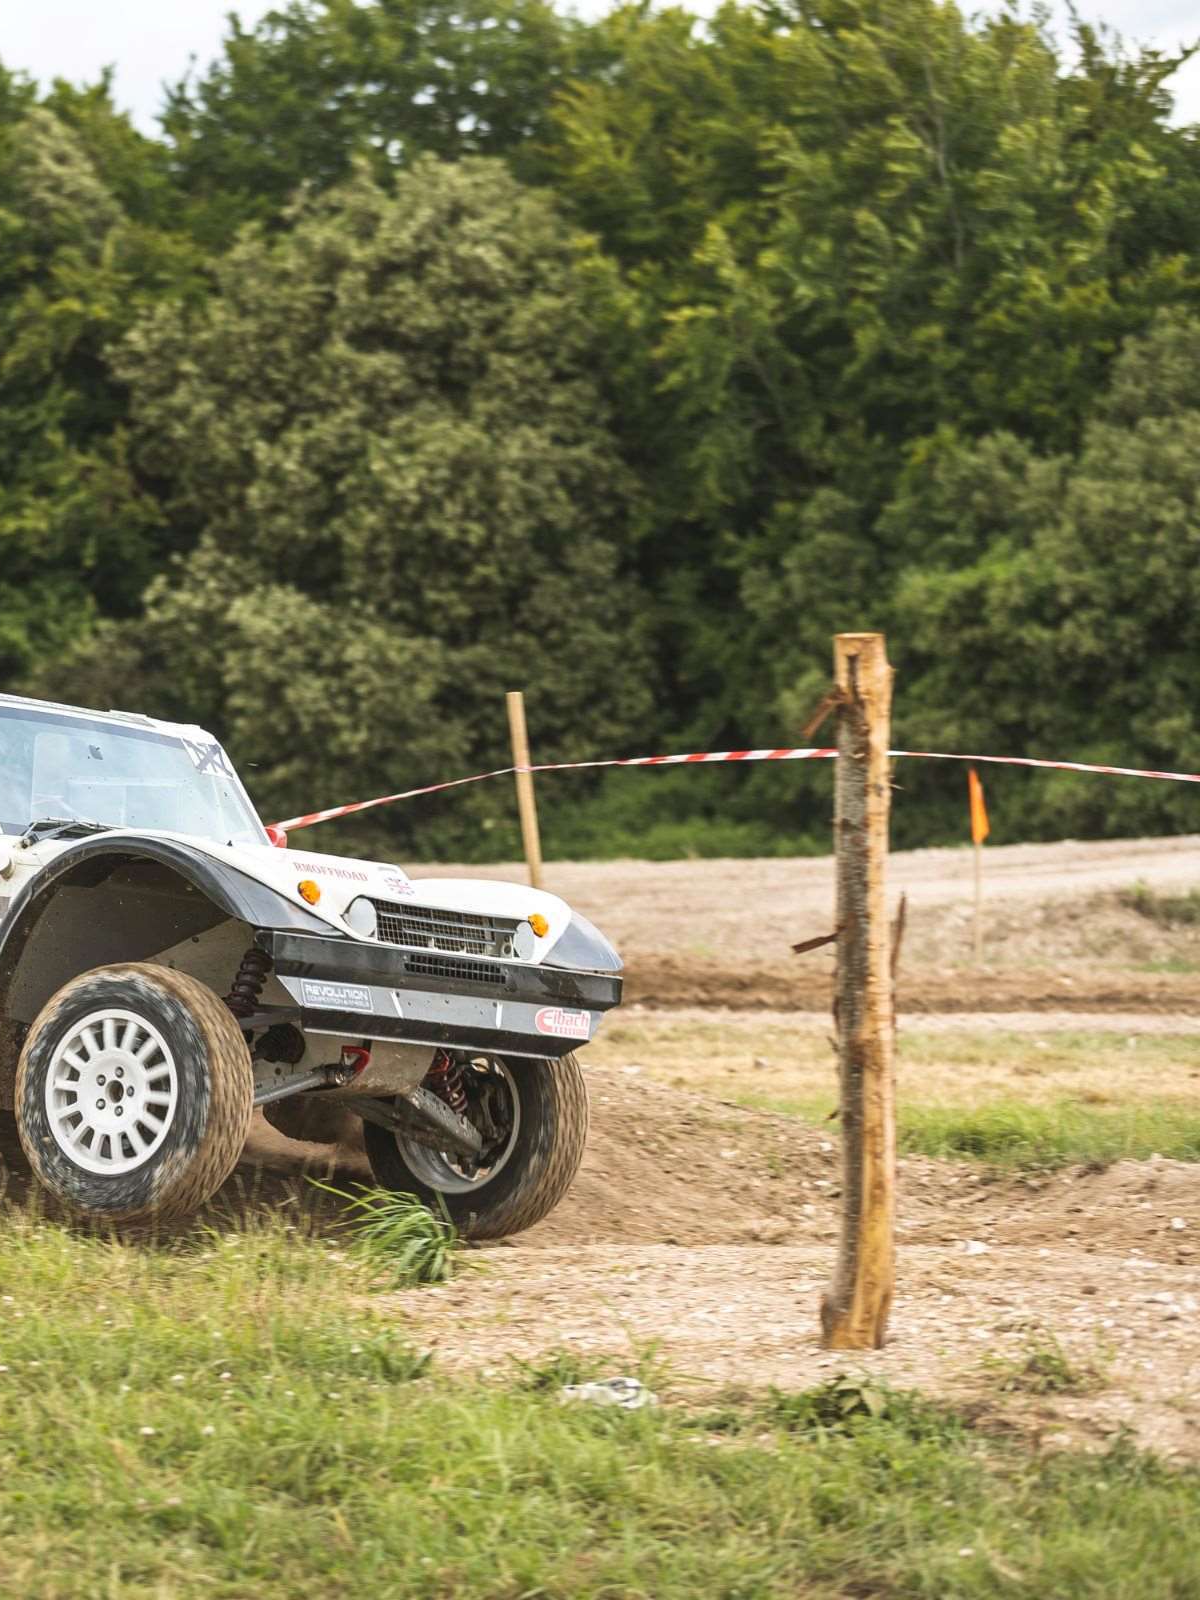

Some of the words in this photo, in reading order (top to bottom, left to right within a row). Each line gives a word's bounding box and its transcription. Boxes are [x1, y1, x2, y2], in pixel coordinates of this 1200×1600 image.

[292, 861, 369, 881] RMOFFROAD
[304, 983, 369, 1001] REVOLUTION
[536, 1009, 589, 1034] Eibach
